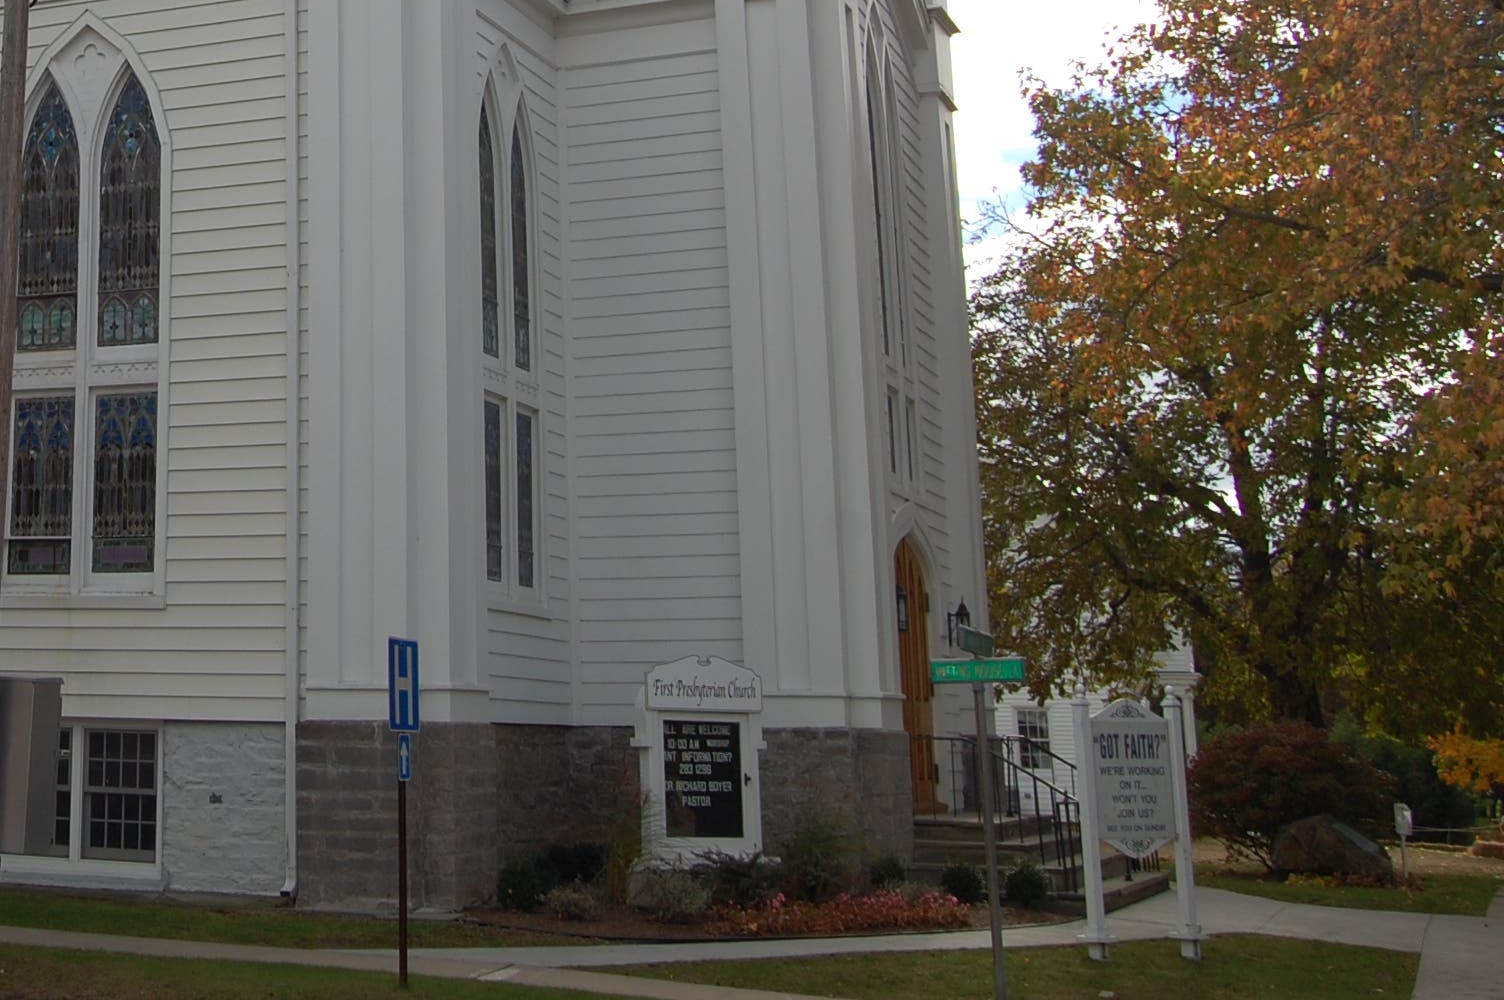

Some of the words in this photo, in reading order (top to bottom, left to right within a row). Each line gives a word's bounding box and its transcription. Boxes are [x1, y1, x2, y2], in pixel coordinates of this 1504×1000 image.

[394, 644, 414, 726] H
[653, 679, 674, 697] First
[676, 675, 726, 706] Presbyterian
[727, 677, 756, 699] Church
[698, 725, 731, 736] WELCOME
[679, 763, 693, 774] 283
[1099, 766, 1125, 776] WE'RE
[1127, 766, 1166, 776] WORKING
[1119, 780, 1132, 790] ON
[682, 796, 711, 806] PASTOR
[1112, 794, 1137, 804] WON'T
[1141, 795, 1157, 804] YOU
[1117, 808, 1135, 818] JOIN
[1138, 808, 1154, 818] US?
